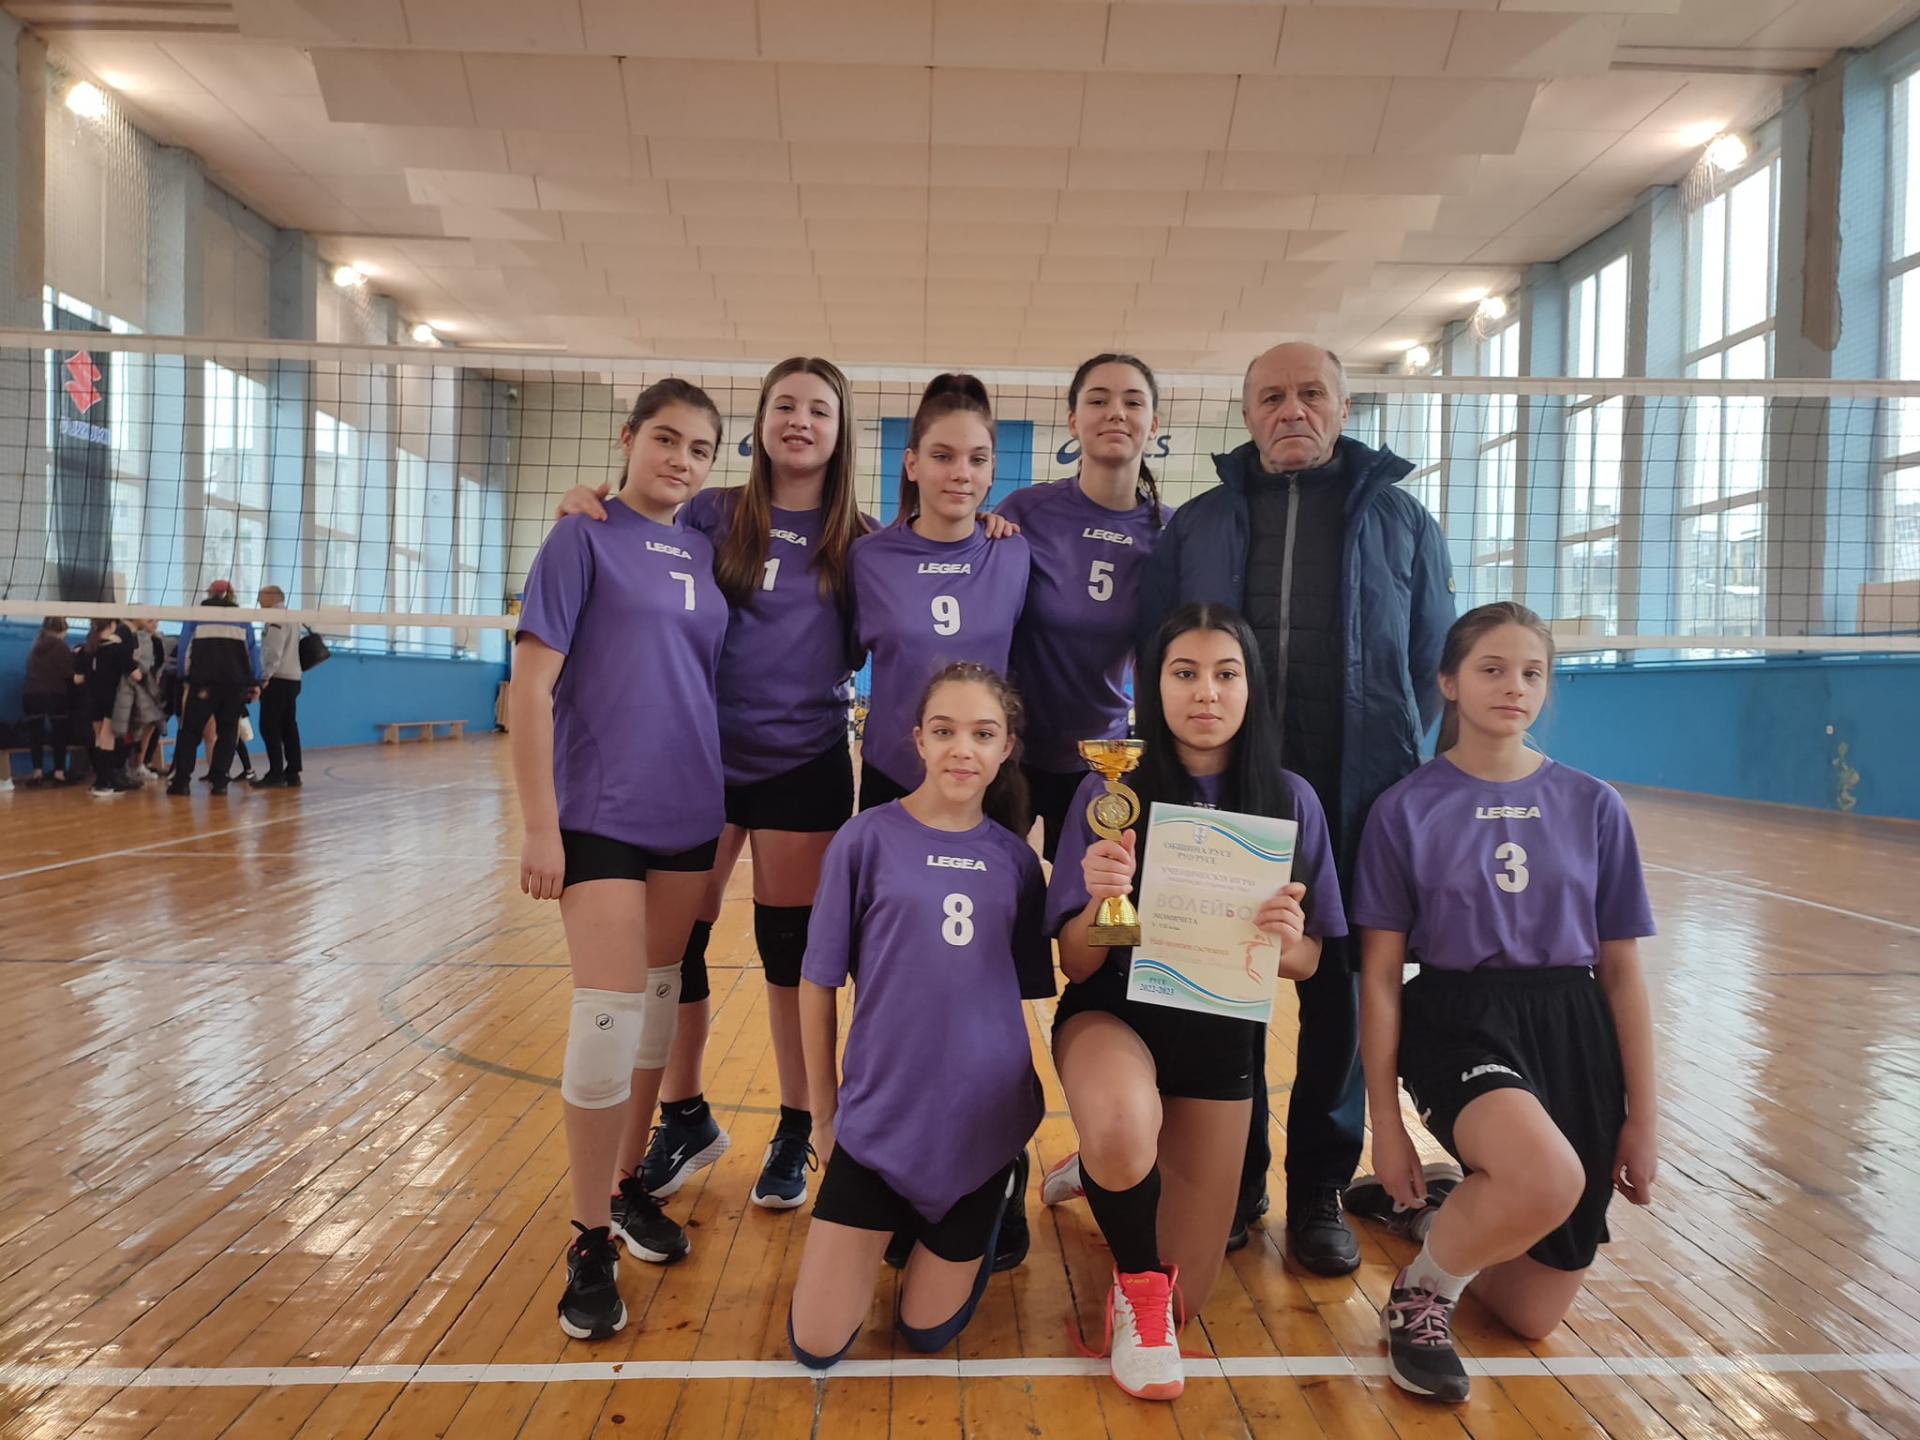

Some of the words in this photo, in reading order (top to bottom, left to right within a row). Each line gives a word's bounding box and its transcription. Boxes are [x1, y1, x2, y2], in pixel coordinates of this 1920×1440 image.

[768, 528, 807, 546] EGEA
[1082, 527, 1134, 546] LEGEA
[645, 541, 692, 560] LEGEA
[763, 558, 781, 591] 1
[917, 562, 971, 575] LEGEA
[1087, 560, 1115, 602] 5
[669, 571, 695, 611] 7
[931, 595, 961, 636] 9
[1475, 806, 1541, 819] LEGEA
[926, 855, 987, 871] LEGEA
[1494, 842, 1530, 893] 3
[942, 893, 974, 946] 8
[1155, 894, 1253, 921] ВОЛЕЙБО
